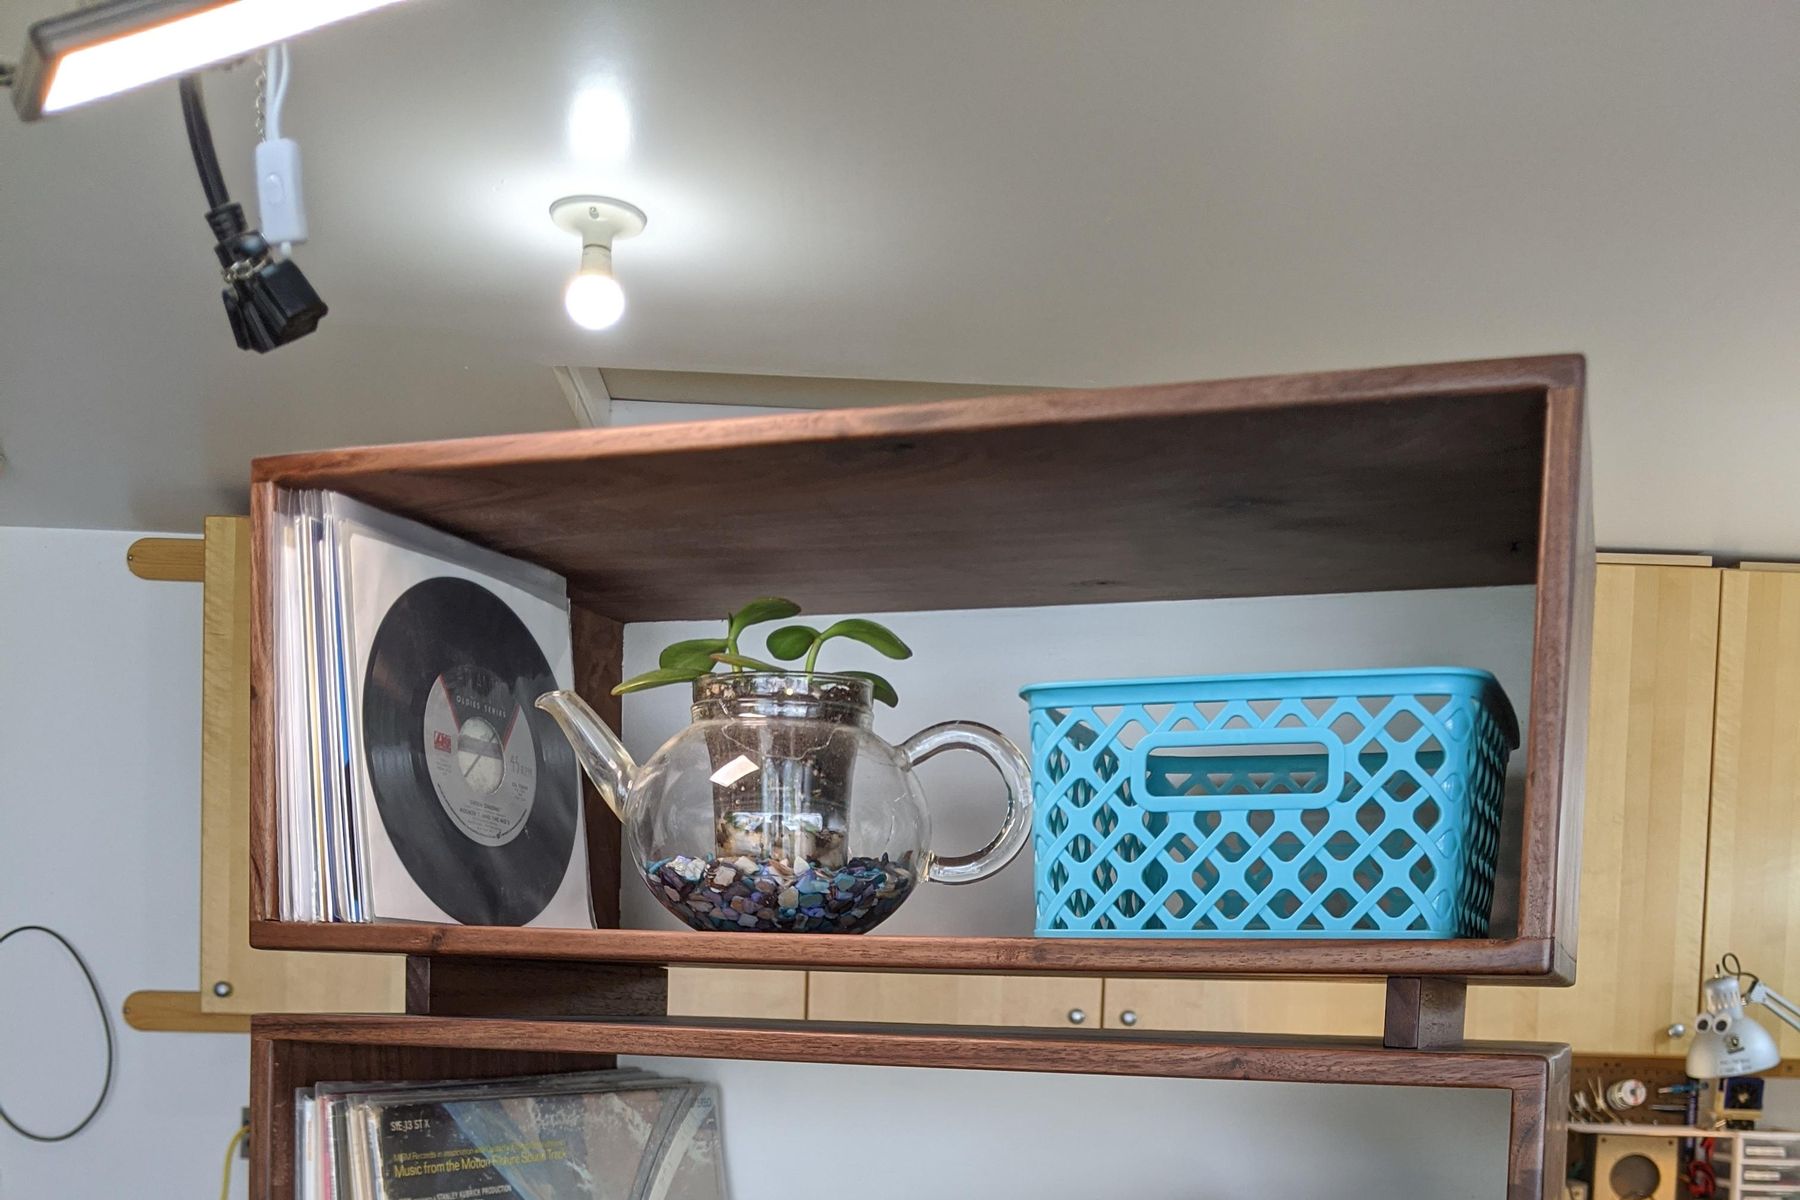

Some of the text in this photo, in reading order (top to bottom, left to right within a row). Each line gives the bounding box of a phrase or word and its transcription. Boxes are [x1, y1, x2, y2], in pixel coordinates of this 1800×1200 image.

[456, 695, 506, 718] OLDIES SERIES
[394, 1163, 422, 1178] Music
[423, 1161, 445, 1175] from
[446, 1160, 460, 1172] the
[461, 1157, 491, 1170] Motion
[436, 1191, 459, 1200] STANLEY
[481, 1184, 513, 1195] PRODUCTION
